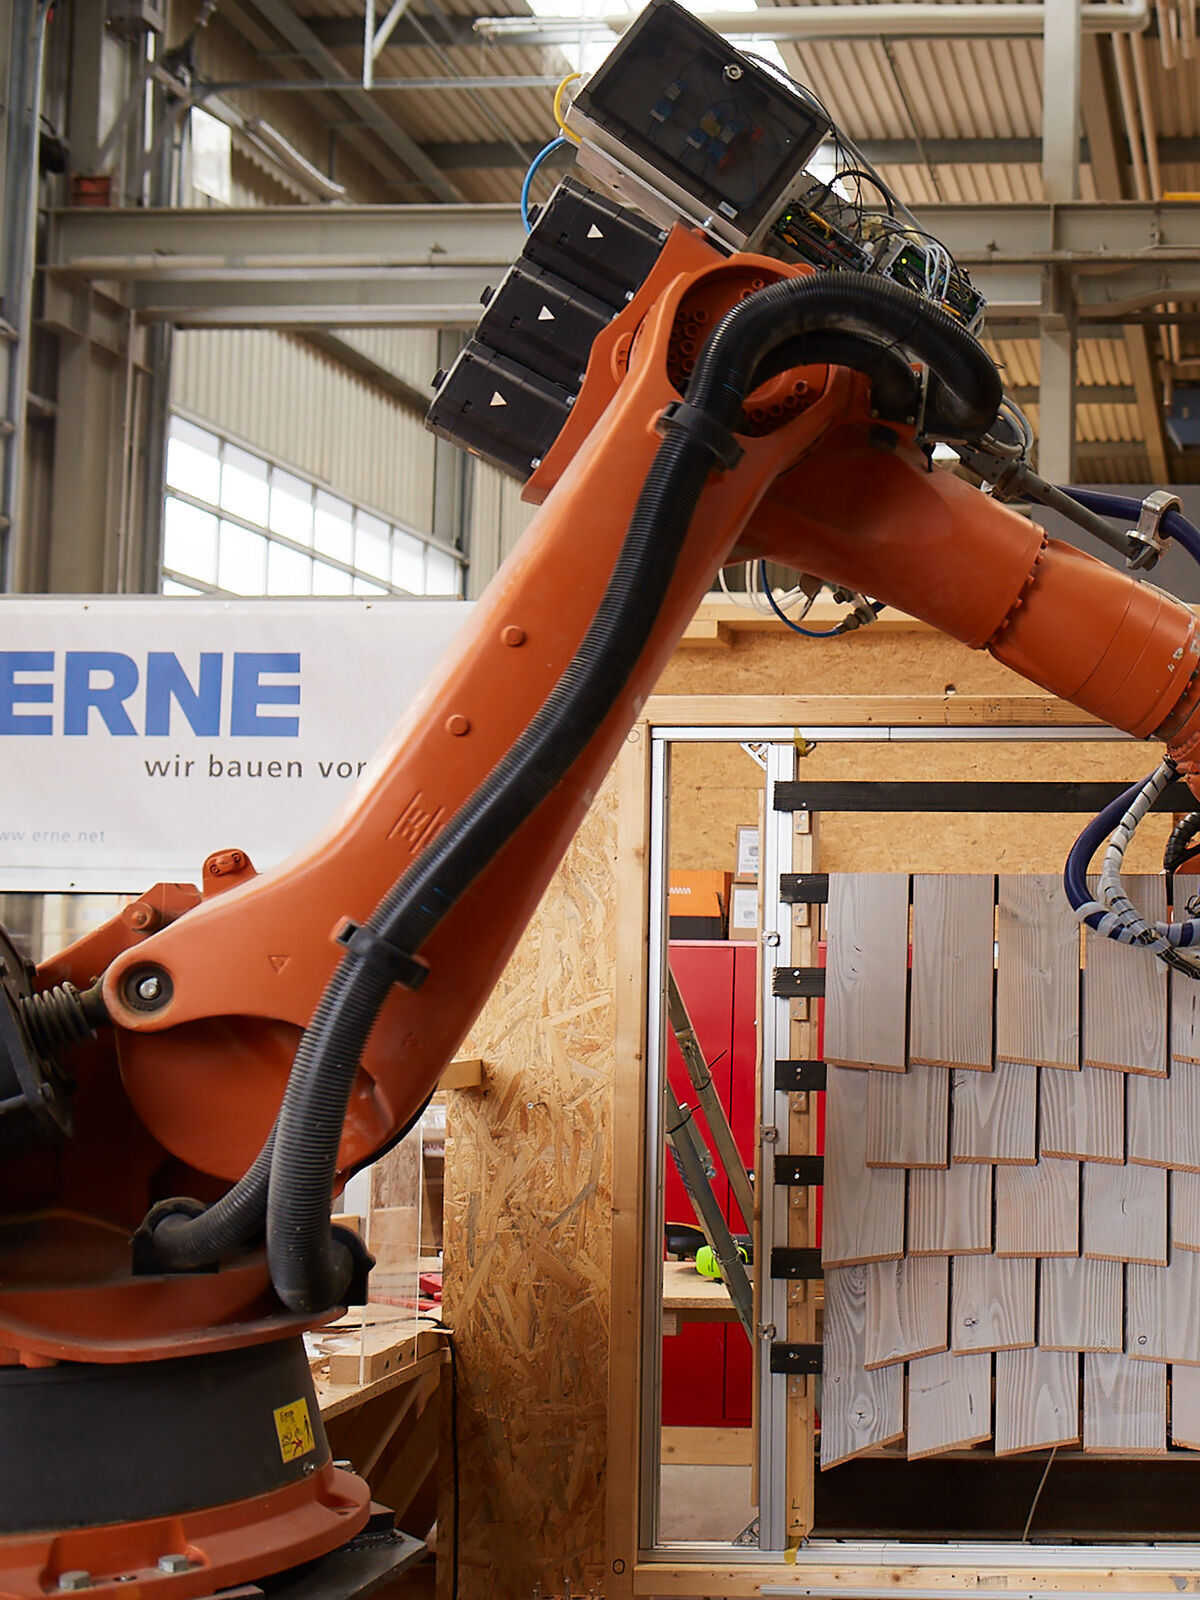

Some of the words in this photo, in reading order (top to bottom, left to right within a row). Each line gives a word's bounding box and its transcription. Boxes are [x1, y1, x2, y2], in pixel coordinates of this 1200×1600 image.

[0, 651, 301, 737] ERNE
[144, 754, 195, 778] wir
[208, 754, 303, 778] bauen
